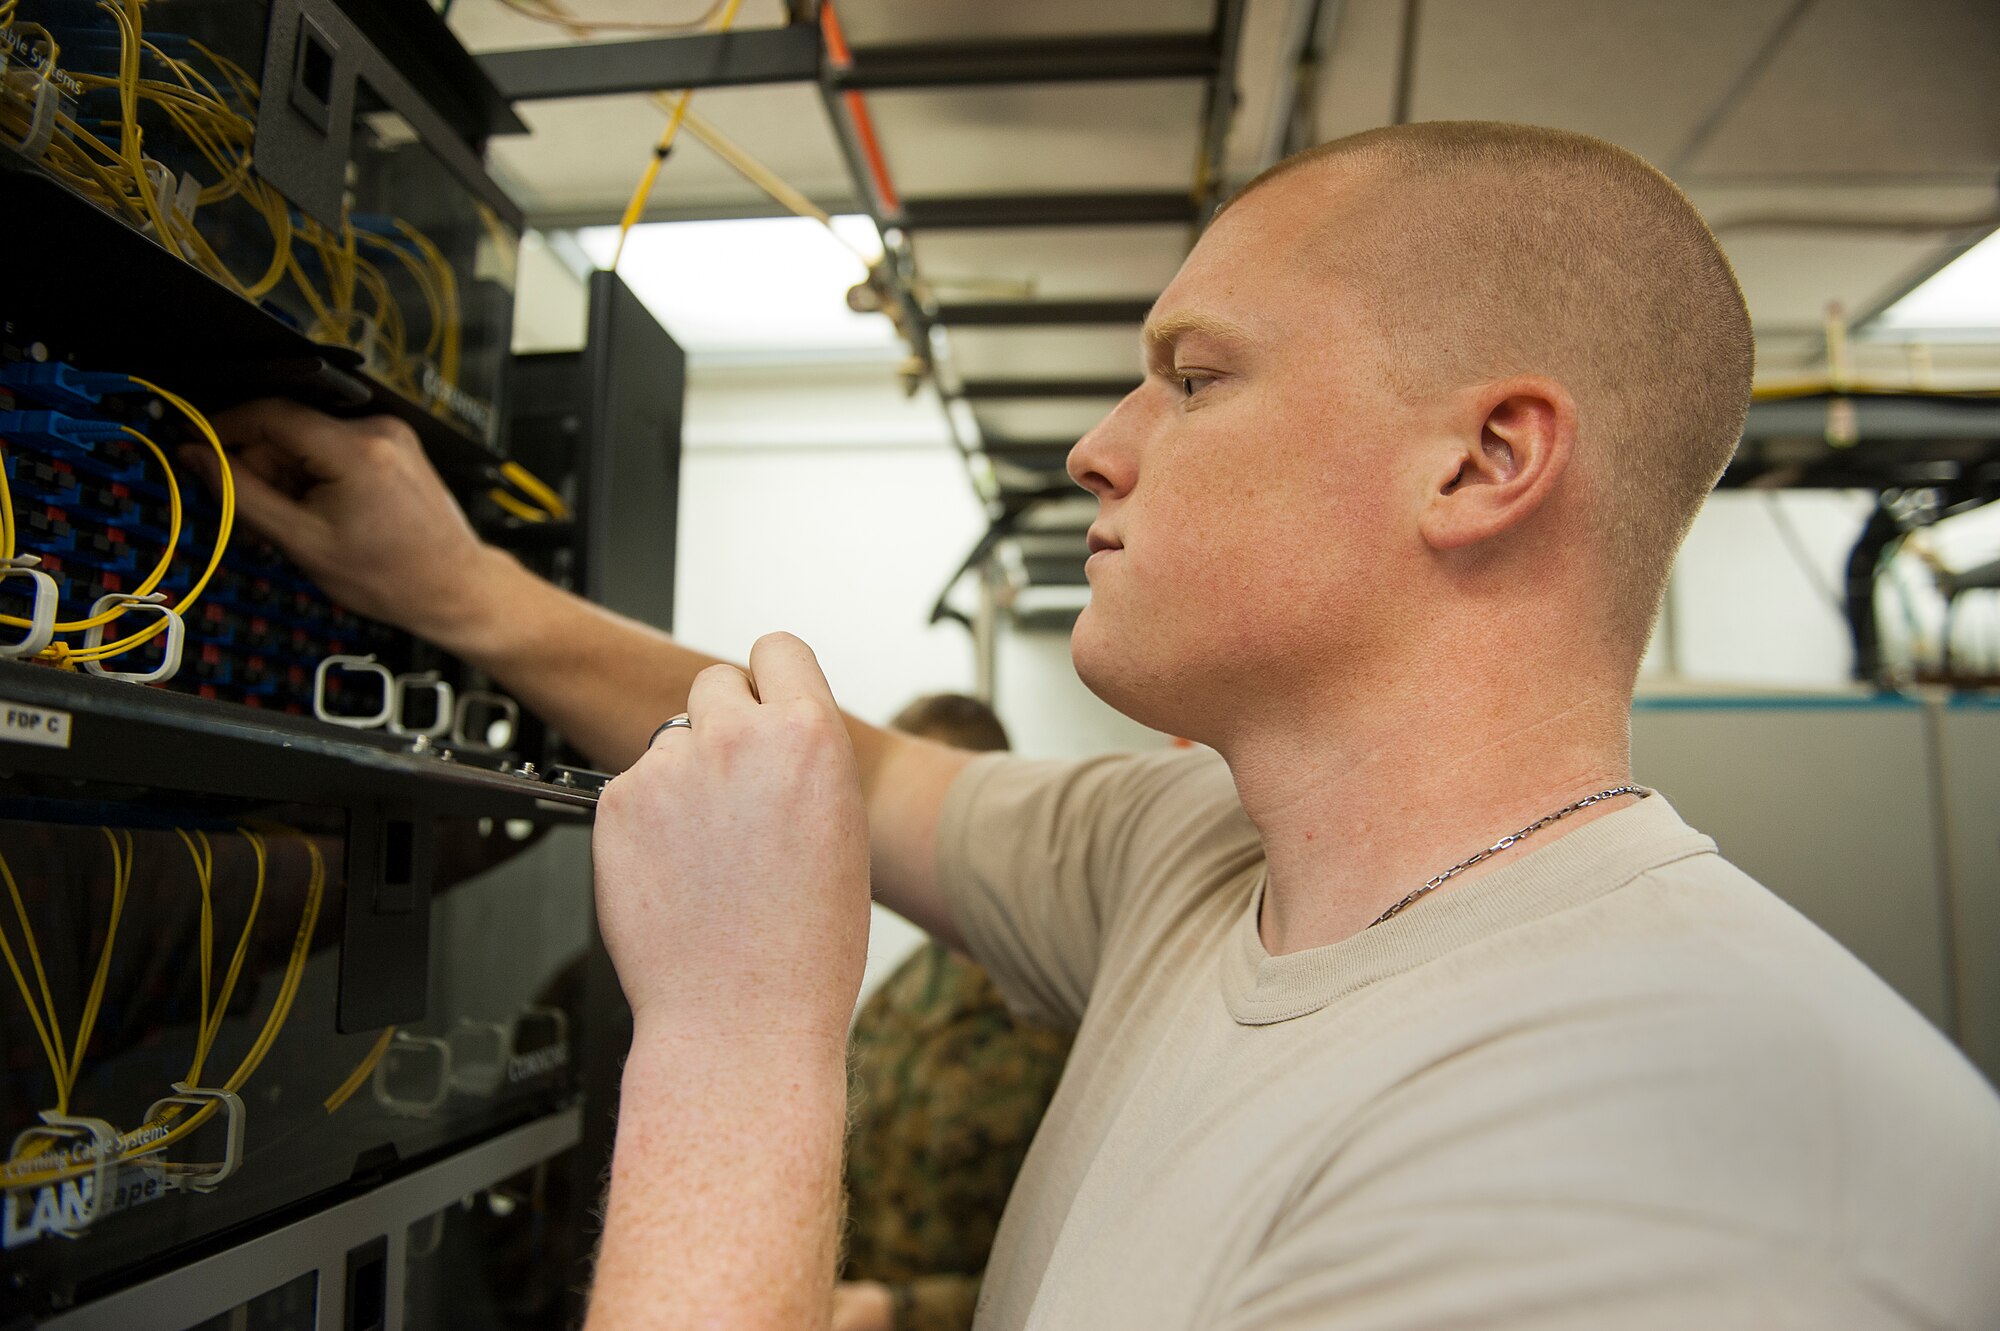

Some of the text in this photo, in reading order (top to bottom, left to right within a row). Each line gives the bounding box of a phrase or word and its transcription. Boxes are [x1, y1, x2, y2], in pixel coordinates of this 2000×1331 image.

[30, 47, 84, 95] Systems
[6, 709, 60, 734] FDP C
[115, 1124, 170, 1152] Systems
